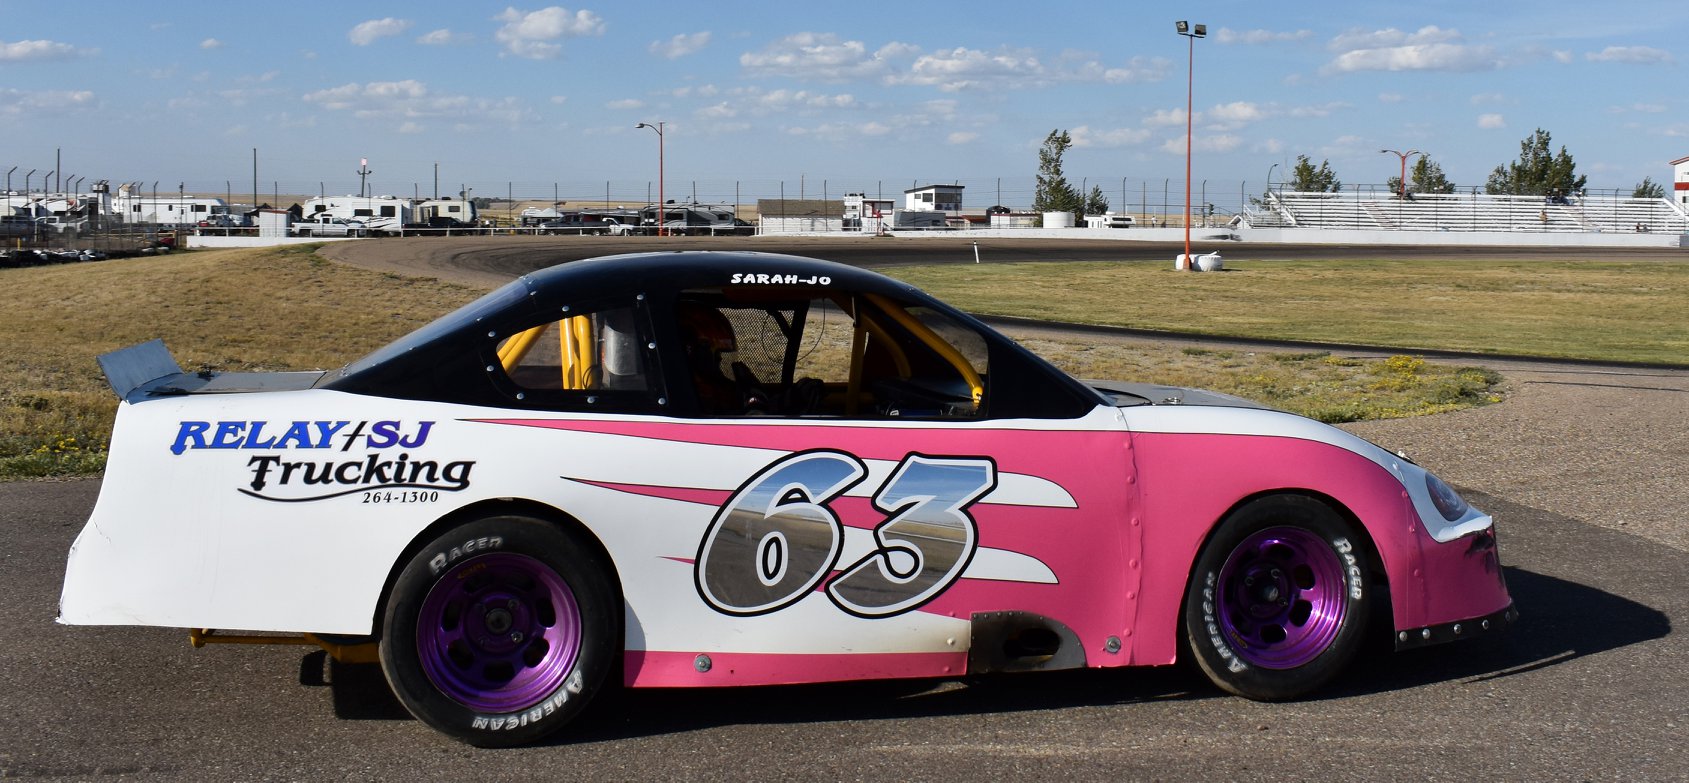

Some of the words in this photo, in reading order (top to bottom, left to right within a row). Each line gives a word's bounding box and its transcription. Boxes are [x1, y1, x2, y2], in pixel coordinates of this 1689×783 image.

[730, 273, 832, 286] SARAH-JO
[247, 453, 477, 491] Trucking
[362, 491, 439, 504] 264-1300
[429, 536, 504, 575] RACER
[694, 448, 999, 619] 63
[1333, 537, 1364, 600] RACER
[1202, 571, 1248, 673] AMERICAN
[472, 669, 584, 731] AMERICAN
